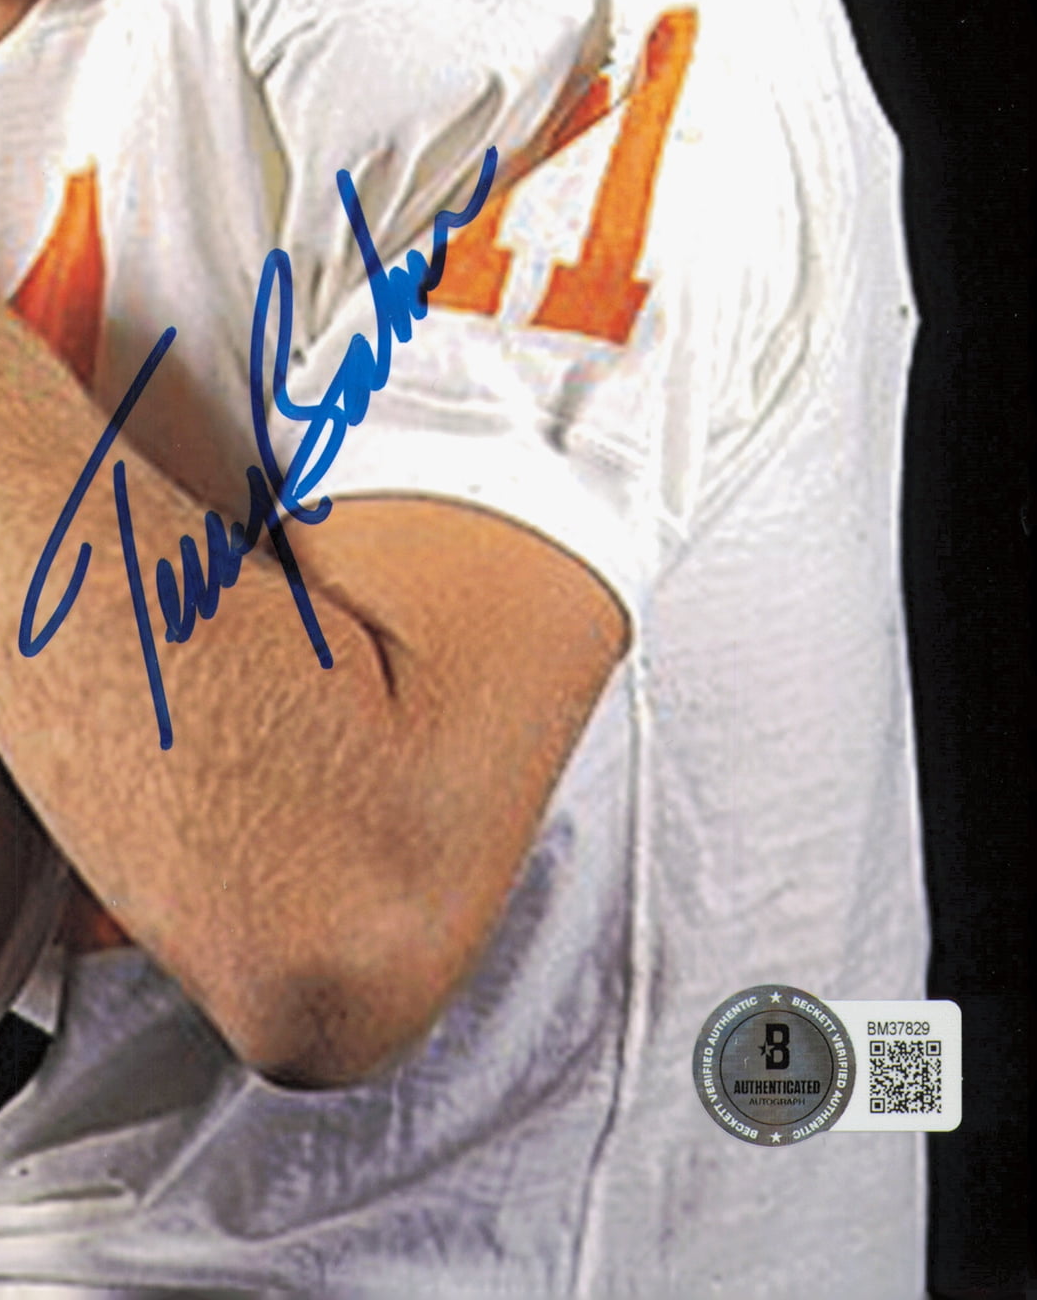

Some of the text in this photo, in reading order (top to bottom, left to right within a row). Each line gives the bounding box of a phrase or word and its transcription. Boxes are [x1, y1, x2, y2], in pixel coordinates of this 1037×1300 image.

[866, 1021, 931, 1036] BM37829
[765, 1023, 791, 1070] B
[702, 995, 760, 1140] BECKETT VERIFIED AUTHENTIC
[791, 995, 849, 1140] BECKETT VERIFIED AUTHENTIC
[733, 1079, 821, 1095] AUTHENTICATED
[748, 1097, 806, 1106] AUTOGRAPH
